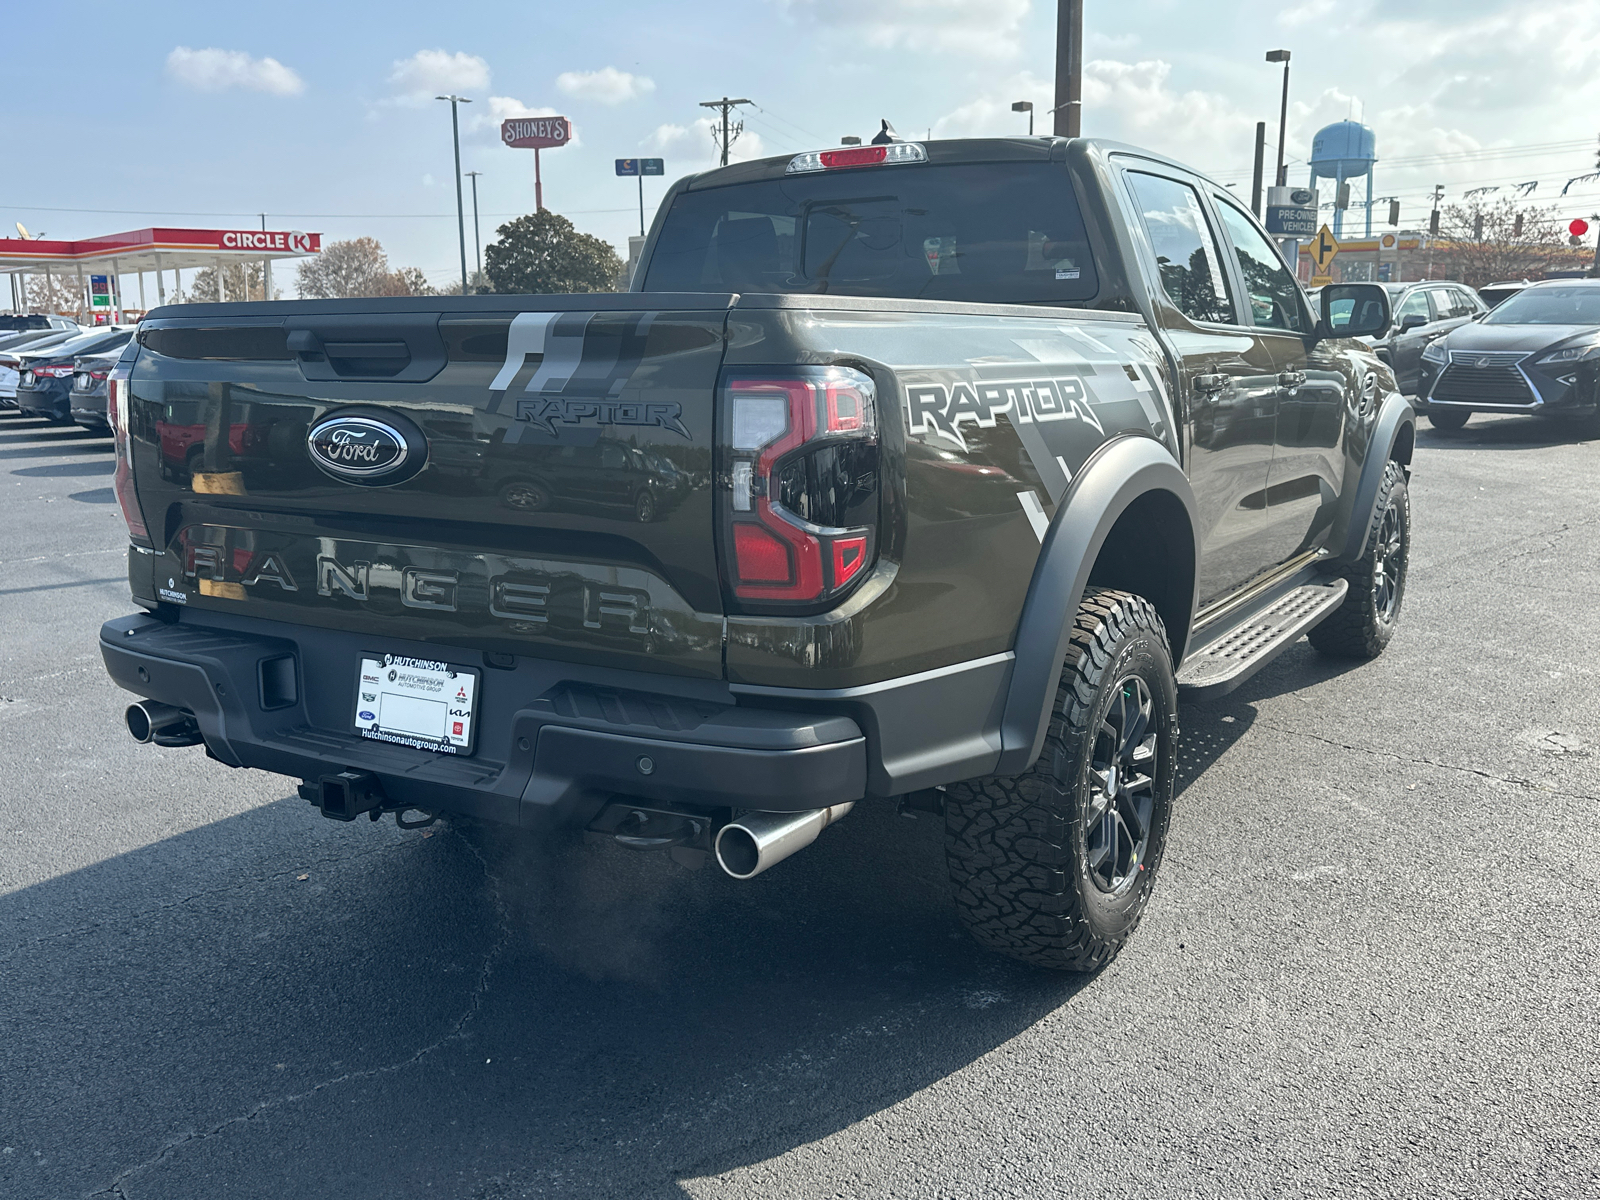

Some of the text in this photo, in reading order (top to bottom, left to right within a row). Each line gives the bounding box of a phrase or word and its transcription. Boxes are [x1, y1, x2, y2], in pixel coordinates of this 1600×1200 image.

[504, 120, 564, 142] SHONEY'S
[1278, 209, 1316, 220] PRE-OWNED
[1282, 221, 1315, 232] VEHICLES
[223, 232, 310, 252] CIRCLE K
[514, 398, 693, 442] RAPTOR
[904, 376, 1106, 455] RAPTOR
[327, 429, 380, 462] Ford
[182, 541, 652, 634] RANGER
[394, 656, 448, 672] HUTCHINSON
[398, 682, 442, 693] AUTOMOTIVE GROUP
[450, 709, 471, 718] KIA
[362, 729, 457, 754] Hutchinsonautogroup.com
